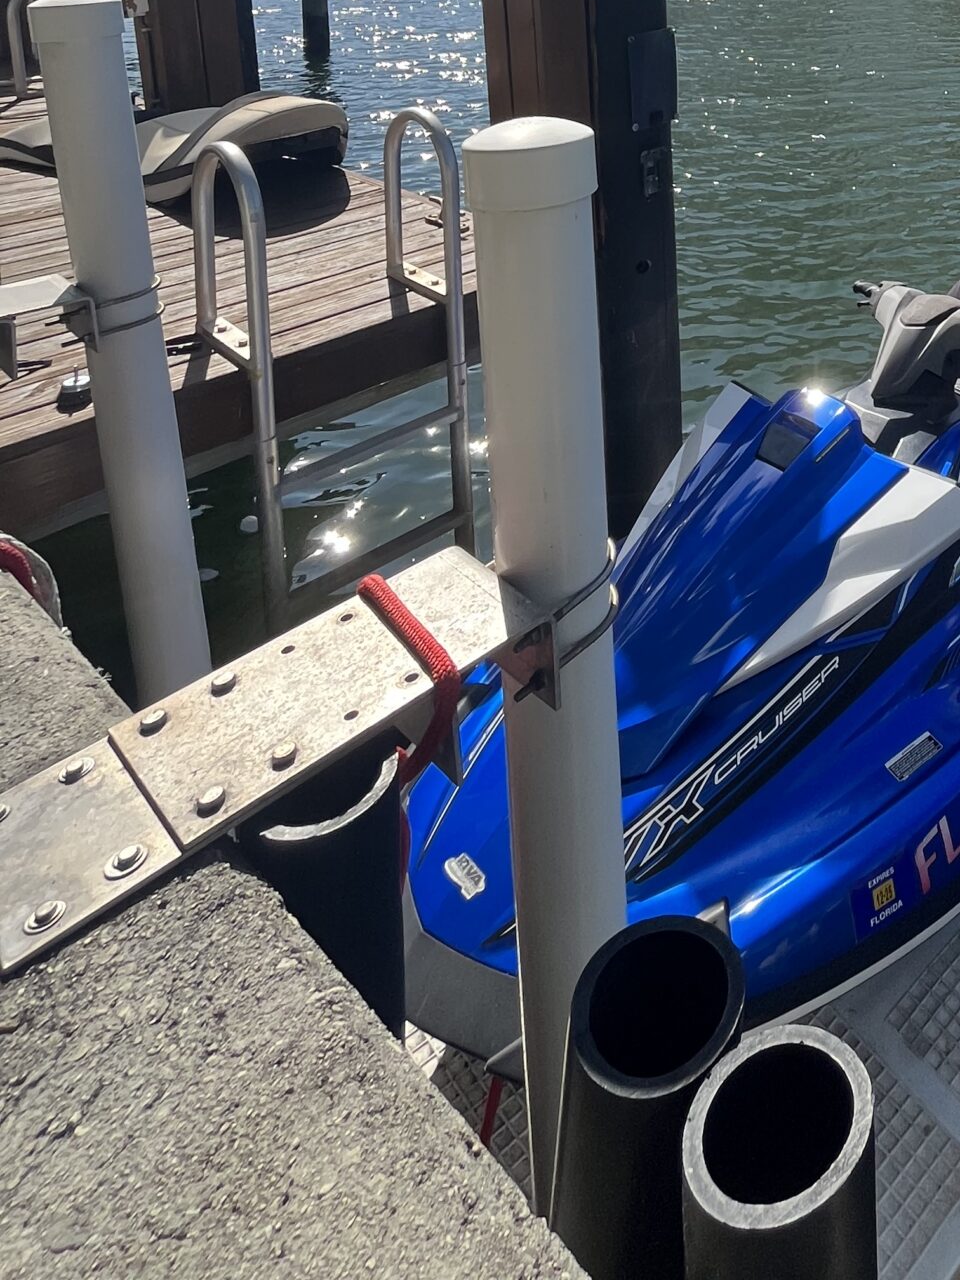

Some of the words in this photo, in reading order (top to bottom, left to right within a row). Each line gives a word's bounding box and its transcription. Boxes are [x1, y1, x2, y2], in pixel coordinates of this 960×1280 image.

[714, 656, 839, 785] CRUISER
[867, 866, 895, 889] EXPIRES
[870, 899, 904, 928] FLORIDA
